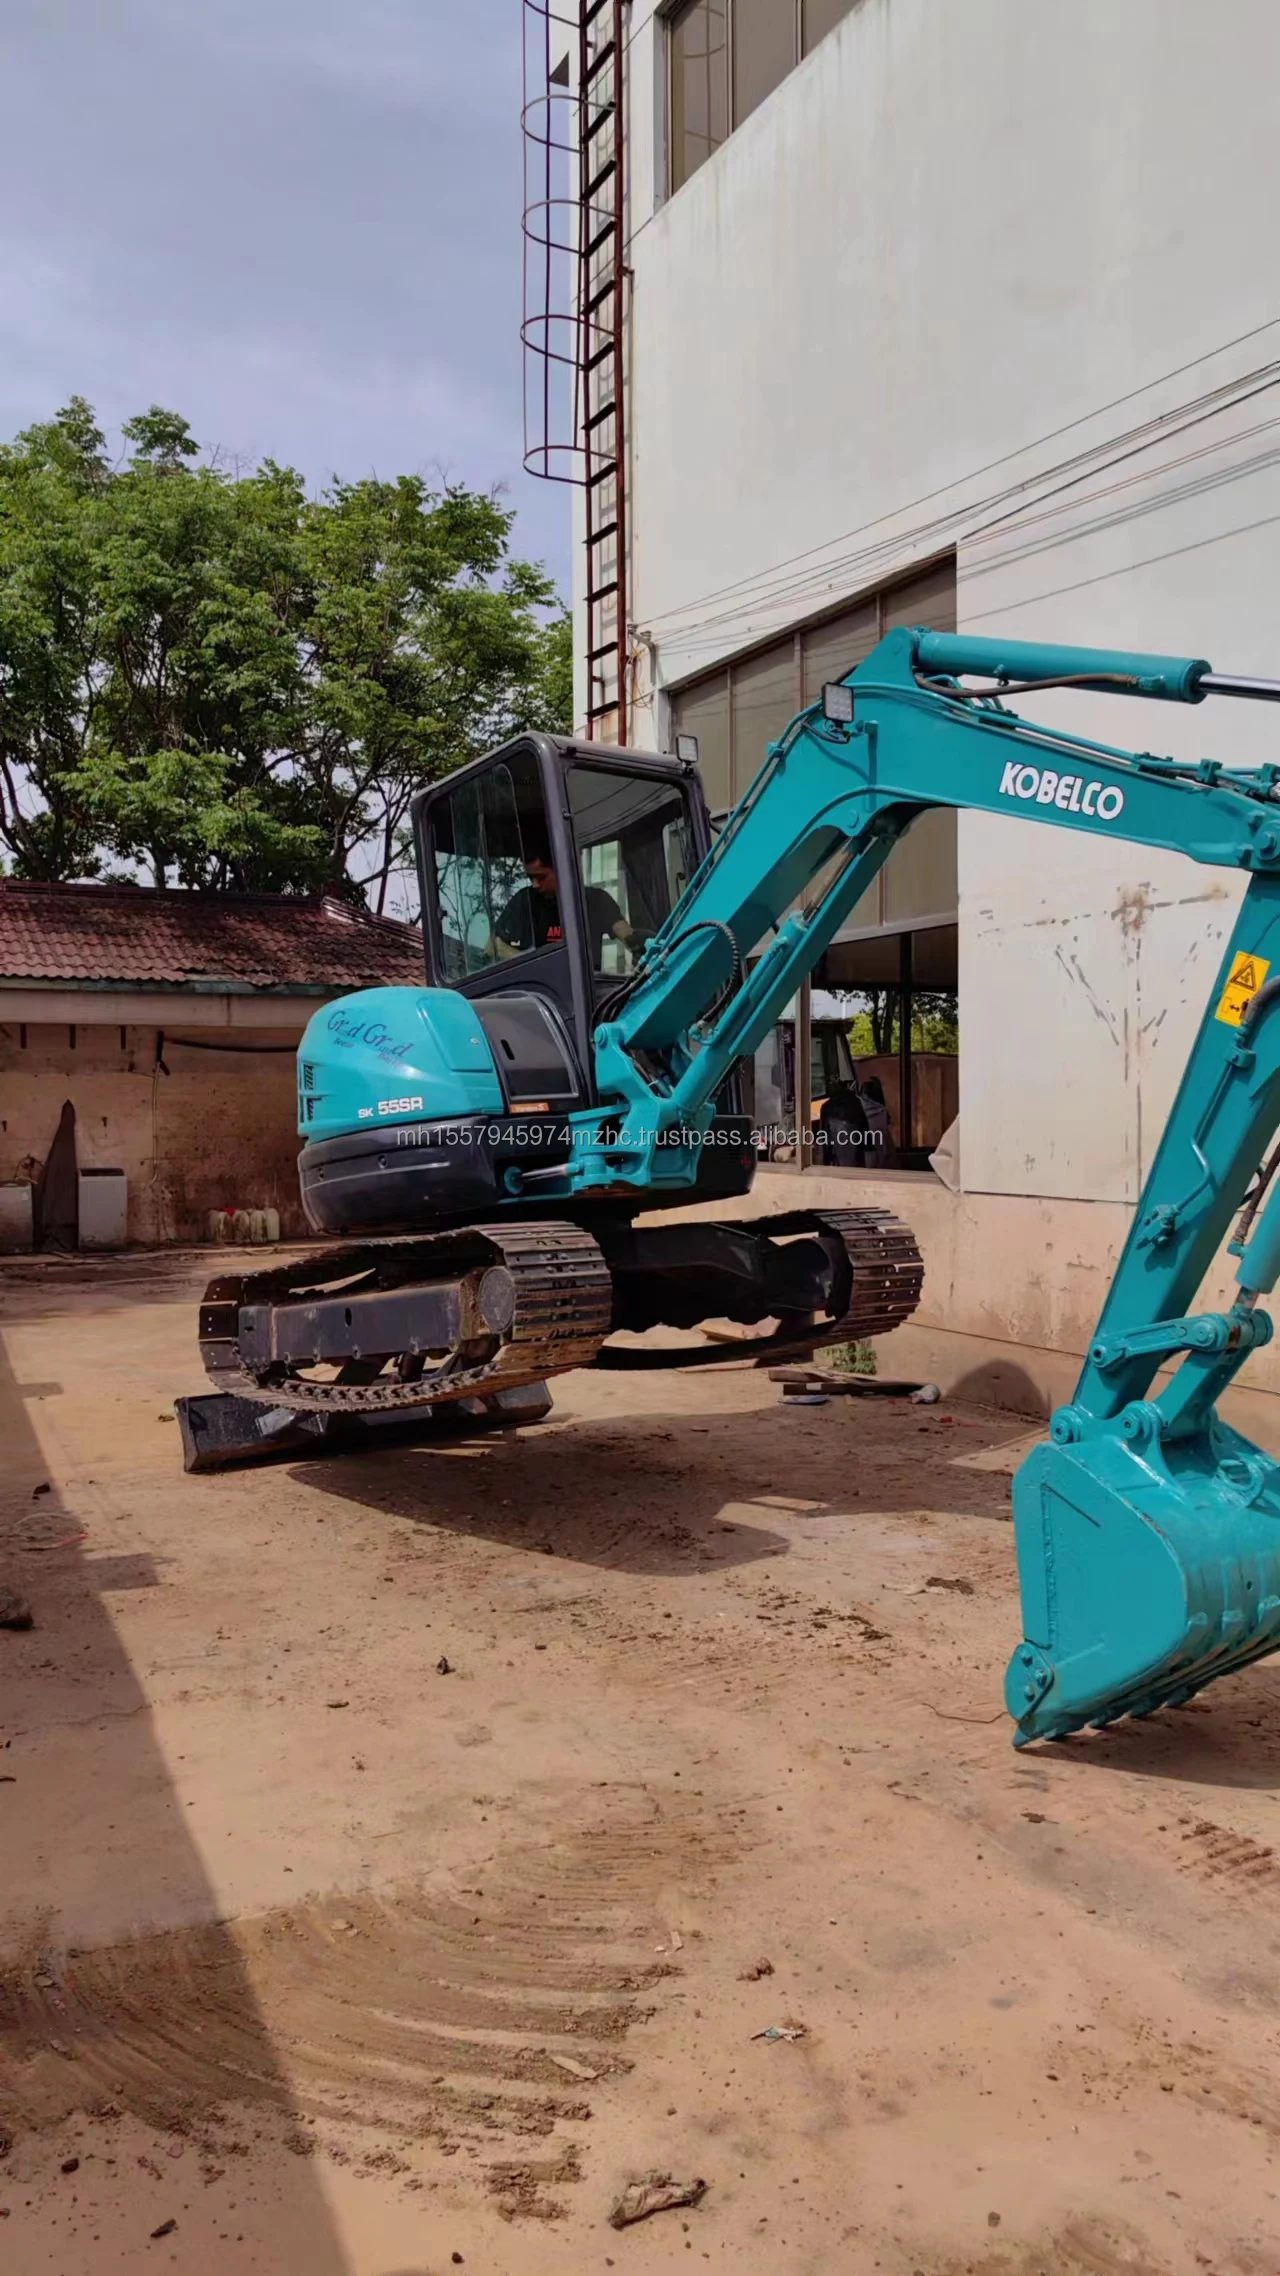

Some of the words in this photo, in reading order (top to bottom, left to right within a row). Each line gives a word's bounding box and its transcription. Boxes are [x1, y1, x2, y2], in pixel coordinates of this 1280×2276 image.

[999, 761, 1125, 821] KOBELCO
[358, 1107, 374, 1119] SK
[377, 1096, 424, 1116] 55SR
